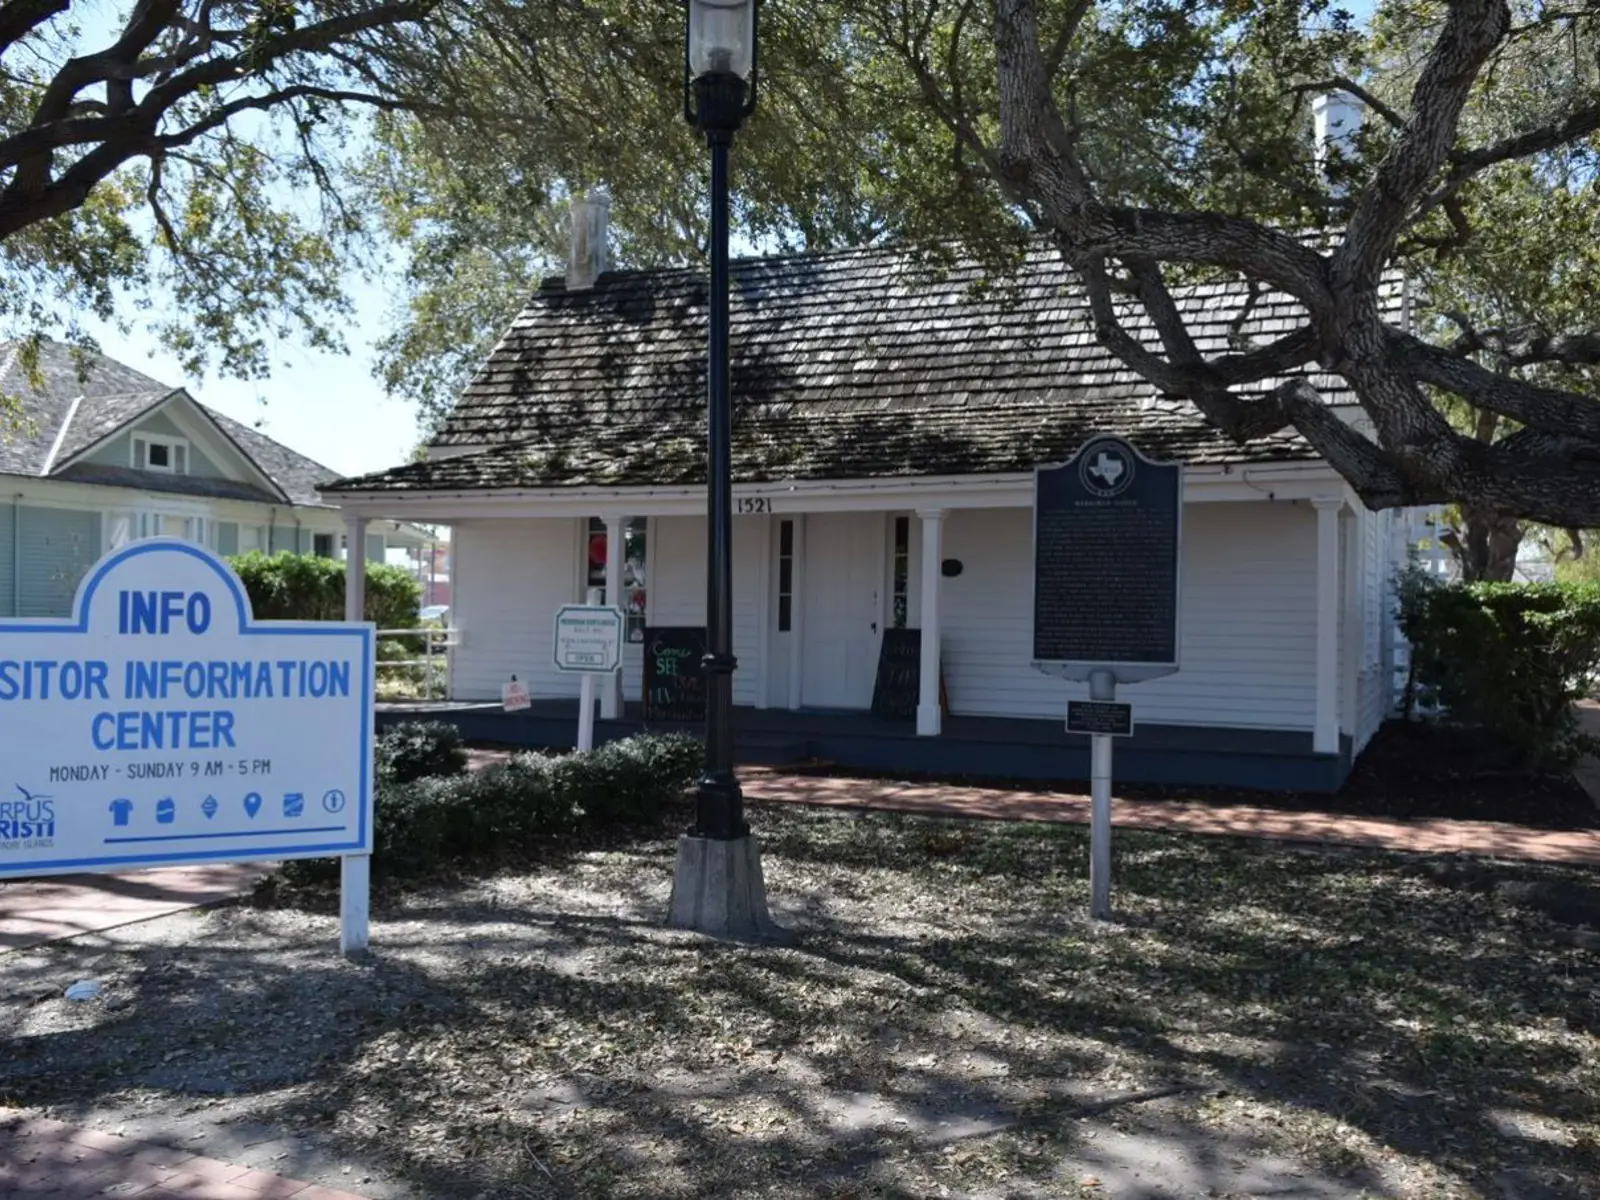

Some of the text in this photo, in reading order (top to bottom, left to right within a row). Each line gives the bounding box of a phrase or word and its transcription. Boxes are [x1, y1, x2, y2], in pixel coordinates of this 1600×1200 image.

[738, 497, 772, 513] 1521
[119, 591, 211, 635] INFO
[0, 660, 349, 701] SITOR INFORMATION
[92, 710, 236, 750] CENTER
[50, 764, 109, 782] MONDAY
[127, 761, 184, 779] SUNDAY
[190, 762, 199, 777] 9
[204, 762, 223, 776] AM
[238, 761, 248, 775] 5
[252, 759, 271, 775] PM
[0, 800, 55, 821] RPUS
